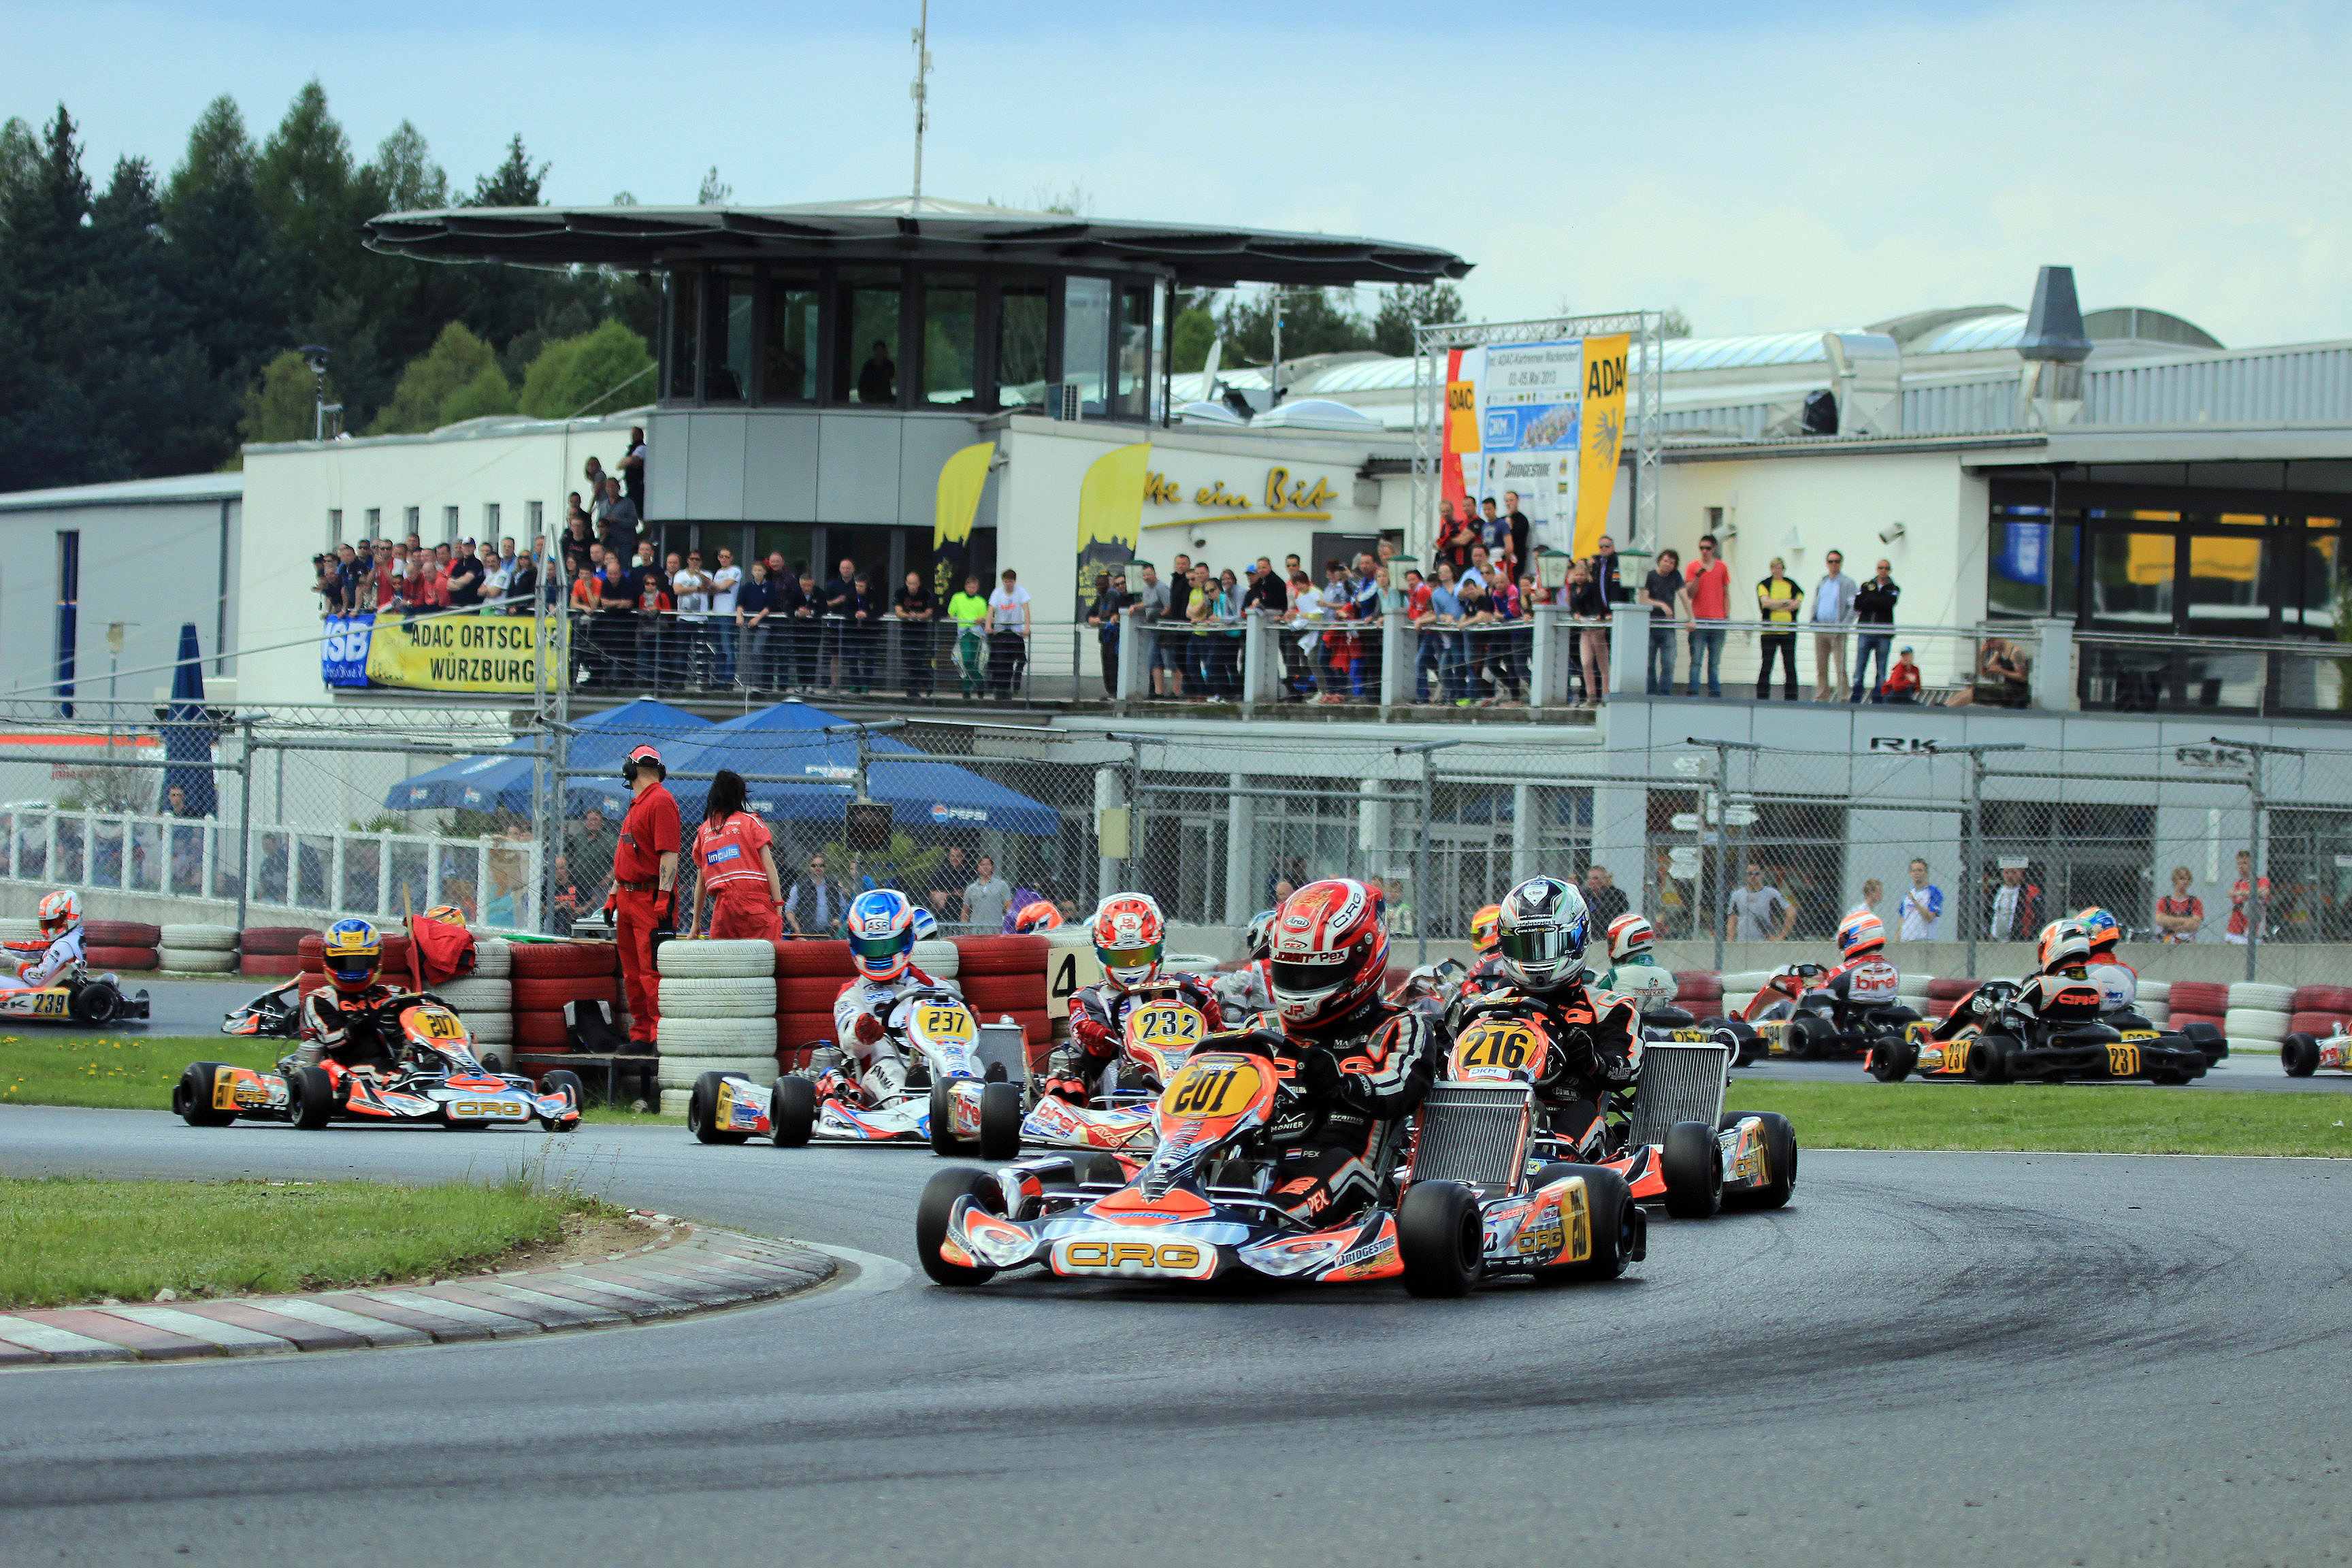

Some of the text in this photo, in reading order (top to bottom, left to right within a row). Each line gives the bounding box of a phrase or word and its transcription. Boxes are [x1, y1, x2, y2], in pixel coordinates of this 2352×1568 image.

[1196, 480, 1253, 508] ein
[1265, 466, 1338, 511] Bit
[411, 624, 453, 648] ADAC
[429, 651, 535, 683] WÜRZBURG
[1333, 892, 1362, 928] CRG
[1319, 950, 1345, 962] Pex
[1051, 953, 1078, 998] 4
[1856, 973, 1896, 990] birel
[34, 993, 65, 1015] 239
[1284, 1004, 1305, 1015] JP
[2058, 994, 2100, 1006] CRG
[426, 1014, 456, 1037] 207
[928, 1011, 965, 1033] 237
[1141, 1010, 1199, 1041] 232
[1463, 1030, 1529, 1068] 216
[1948, 1041, 1968, 1073] 231
[2110, 1047, 2139, 1075] 231
[1471, 1067, 1498, 1075] DKM
[1171, 1070, 1239, 1114] 201
[457, 1101, 522, 1116] CRG
[1270, 1121, 1304, 1133] MONIER
[1108, 1212, 1180, 1221] memotec
[1306, 1188, 1331, 1218] PEX
[1335, 1235, 1396, 1269] BRIDGESTONE
[1517, 1227, 1563, 1254] CRG
[1066, 1241, 1200, 1269] CRG
